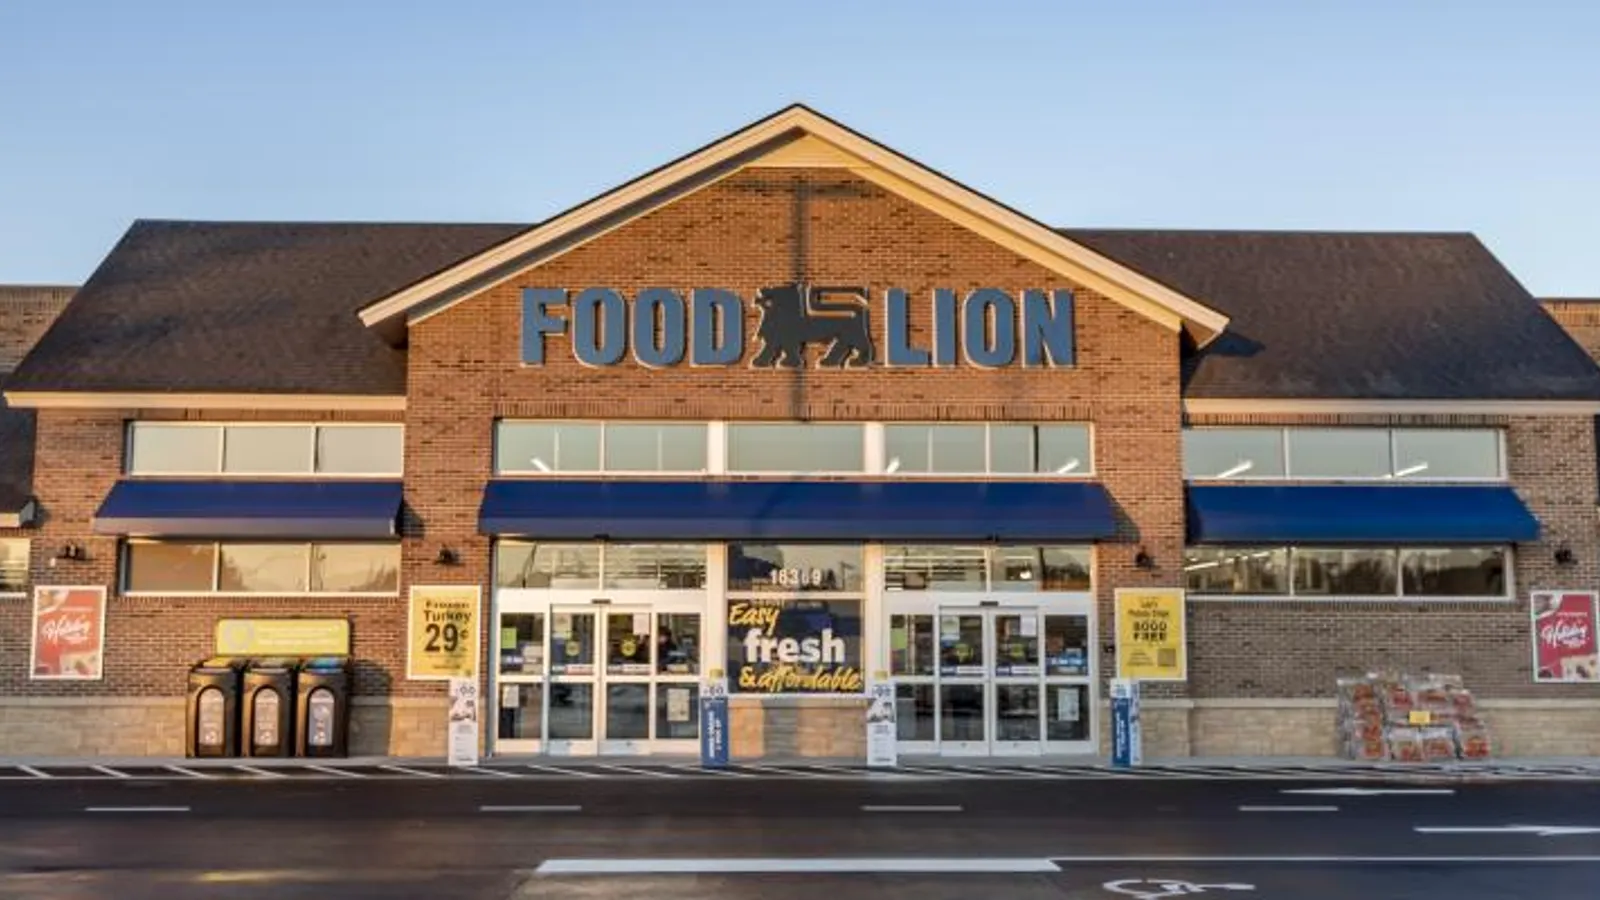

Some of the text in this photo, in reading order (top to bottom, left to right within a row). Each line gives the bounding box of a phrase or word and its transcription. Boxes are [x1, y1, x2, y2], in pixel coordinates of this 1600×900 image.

[520, 287, 1075, 369] FOOD LION
[424, 610, 472, 624] Turkey
[730, 603, 779, 636] Easy
[744, 627, 846, 663] fresh
